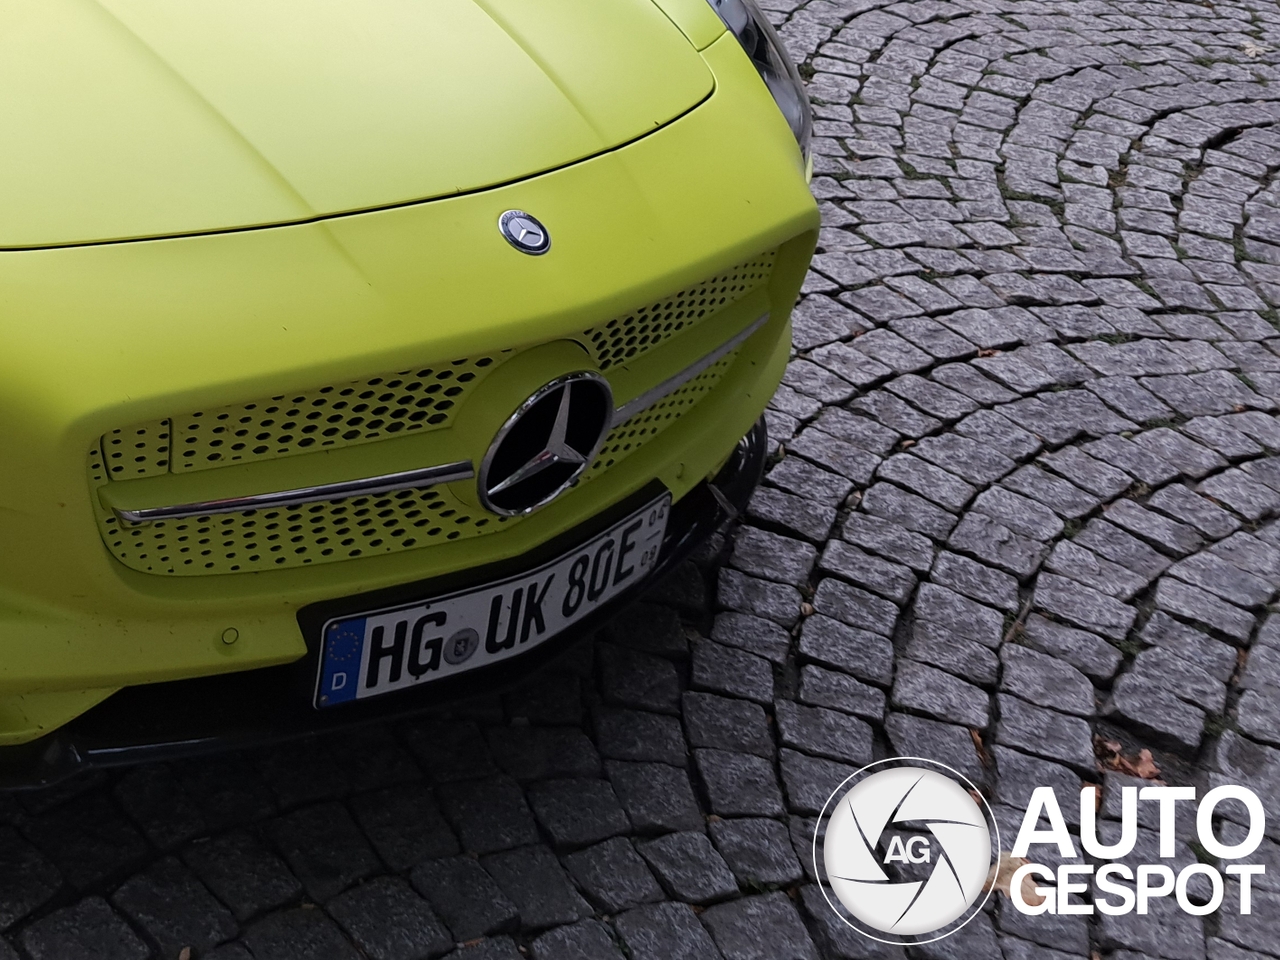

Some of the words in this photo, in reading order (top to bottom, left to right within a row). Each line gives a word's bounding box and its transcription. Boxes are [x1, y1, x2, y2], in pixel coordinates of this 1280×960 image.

[366, 611, 447, 690] HG
[485, 573, 555, 654] UK
[562, 519, 643, 618] 80E
[332, 672, 347, 691] D
